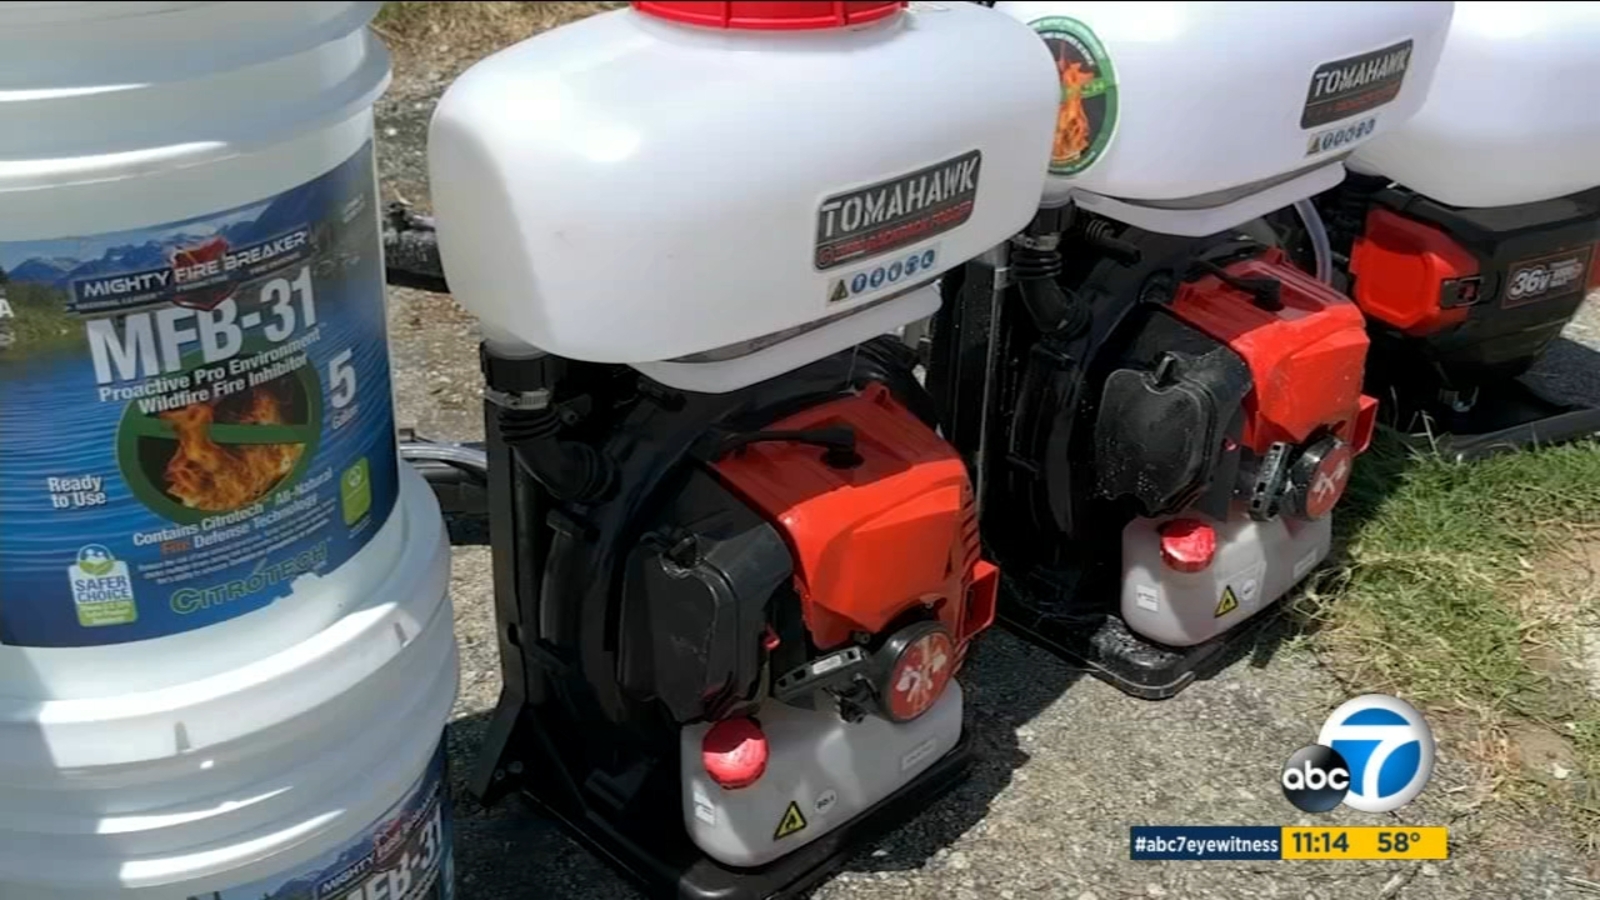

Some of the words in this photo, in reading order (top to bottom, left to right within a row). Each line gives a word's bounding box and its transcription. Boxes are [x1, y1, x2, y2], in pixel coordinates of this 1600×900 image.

[1314, 46, 1412, 98] TOMAHAWK
[821, 156, 979, 237] TOMAHAWK
[84, 269, 173, 298] MIGHTY
[173, 260, 219, 284] FIRE
[223, 231, 306, 270] BREAKER
[86, 266, 318, 385] MFB-31
[100, 372, 190, 402] Proactive
[193, 360, 226, 385] Pro
[229, 328, 321, 375] Environment
[137, 385, 209, 414] Wildfire
[213, 377, 246, 399] Fire
[249, 352, 310, 386] Inhibitor
[329, 348, 356, 409] 5
[48, 474, 103, 497] Ready
[51, 491, 73, 510] to
[74, 487, 107, 507] Use
[133, 521, 199, 547] Contains
[201, 502, 265, 532] Citrotech
[193, 522, 250, 549] Defense
[74, 574, 128, 593] SAFER
[77, 589, 132, 604] CHOICE
[346, 801, 441, 900] FB-31
